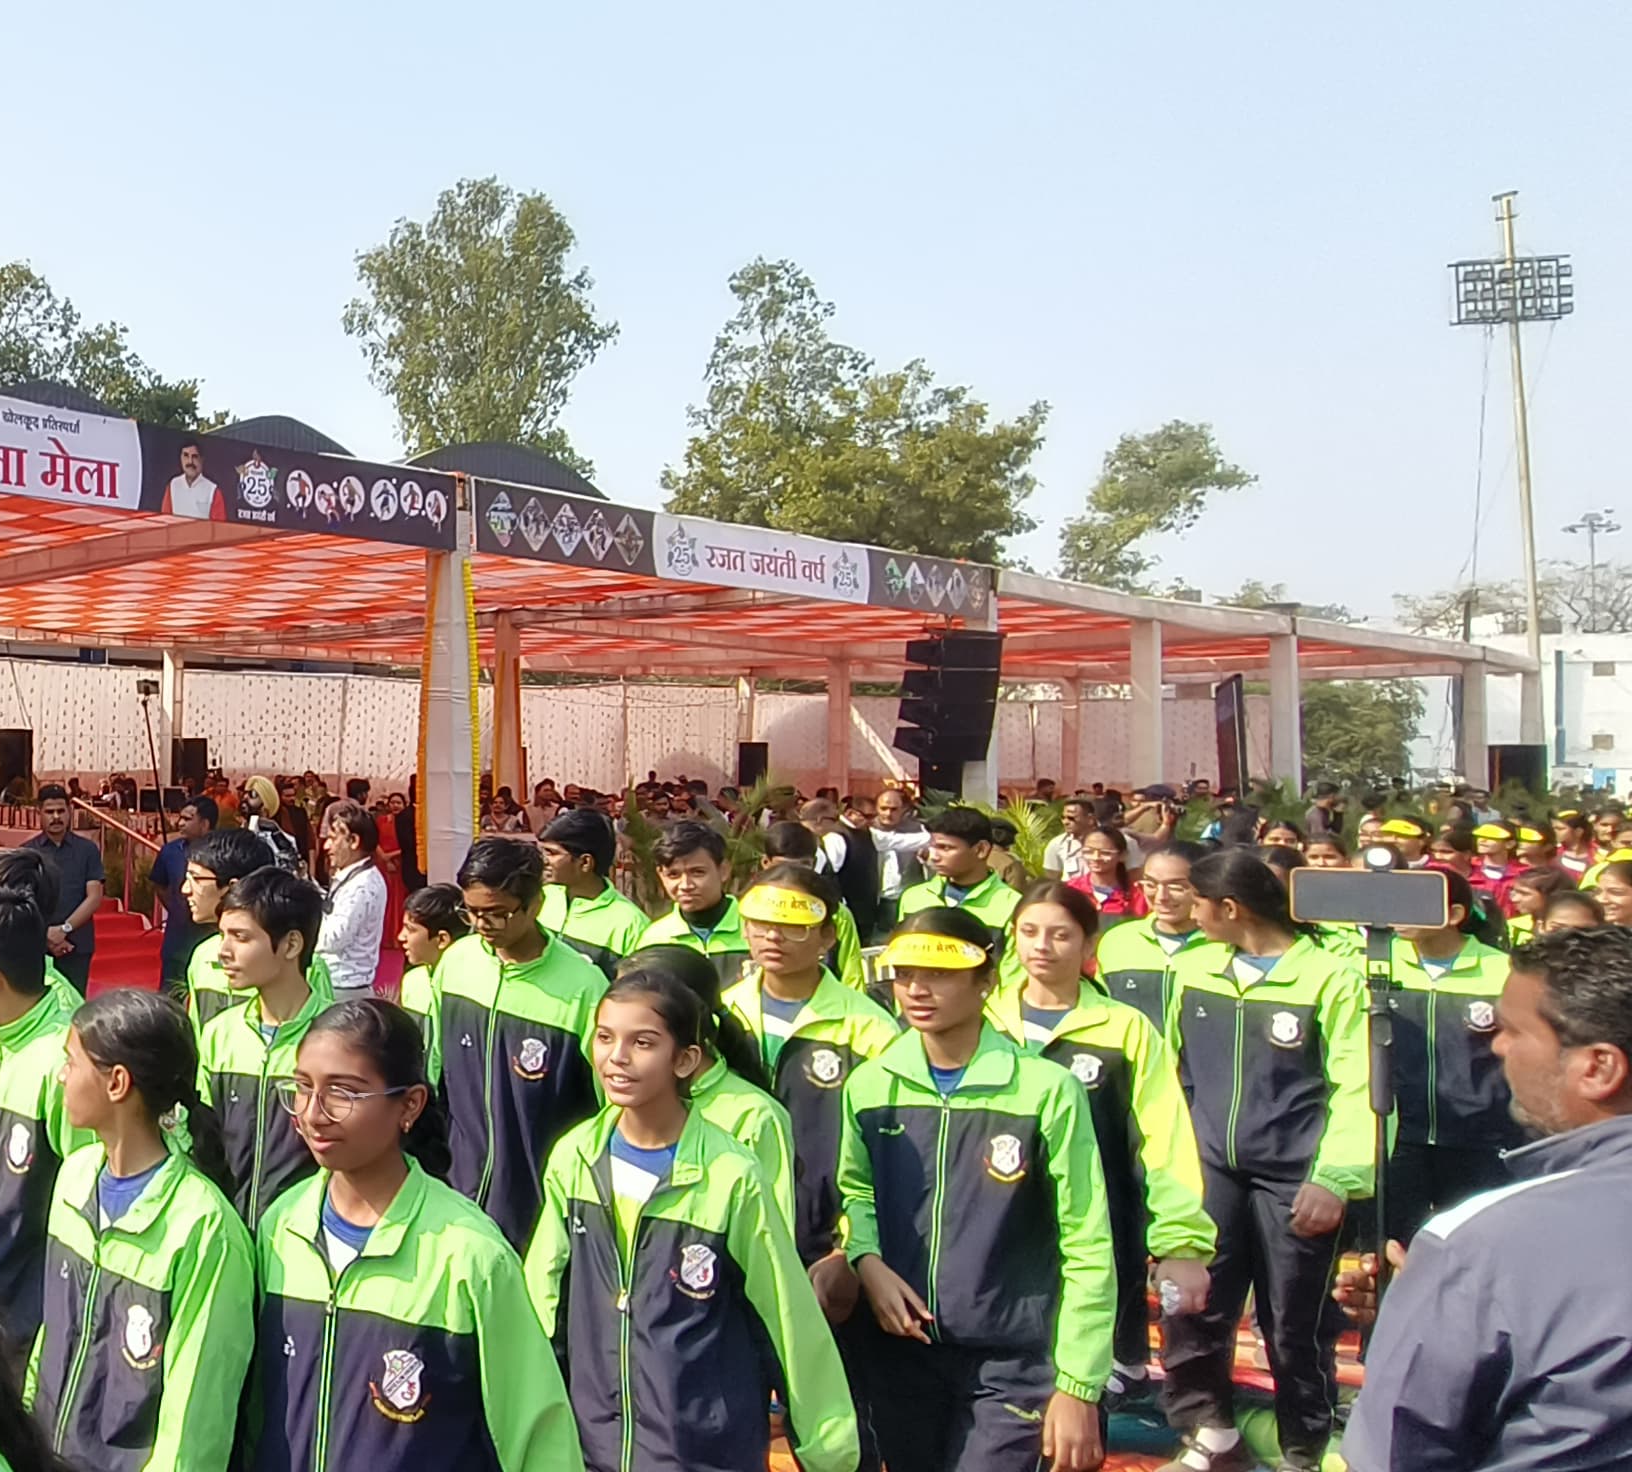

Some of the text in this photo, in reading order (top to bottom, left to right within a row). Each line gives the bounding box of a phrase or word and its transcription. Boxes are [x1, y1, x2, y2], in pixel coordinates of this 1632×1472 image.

[39, 437, 120, 499] मेला
[247, 477, 267, 496] 25
[673, 545, 690, 565] 25
[704, 545, 826, 584] रजत जयंती वर्ष
[838, 571, 853, 588] 25
